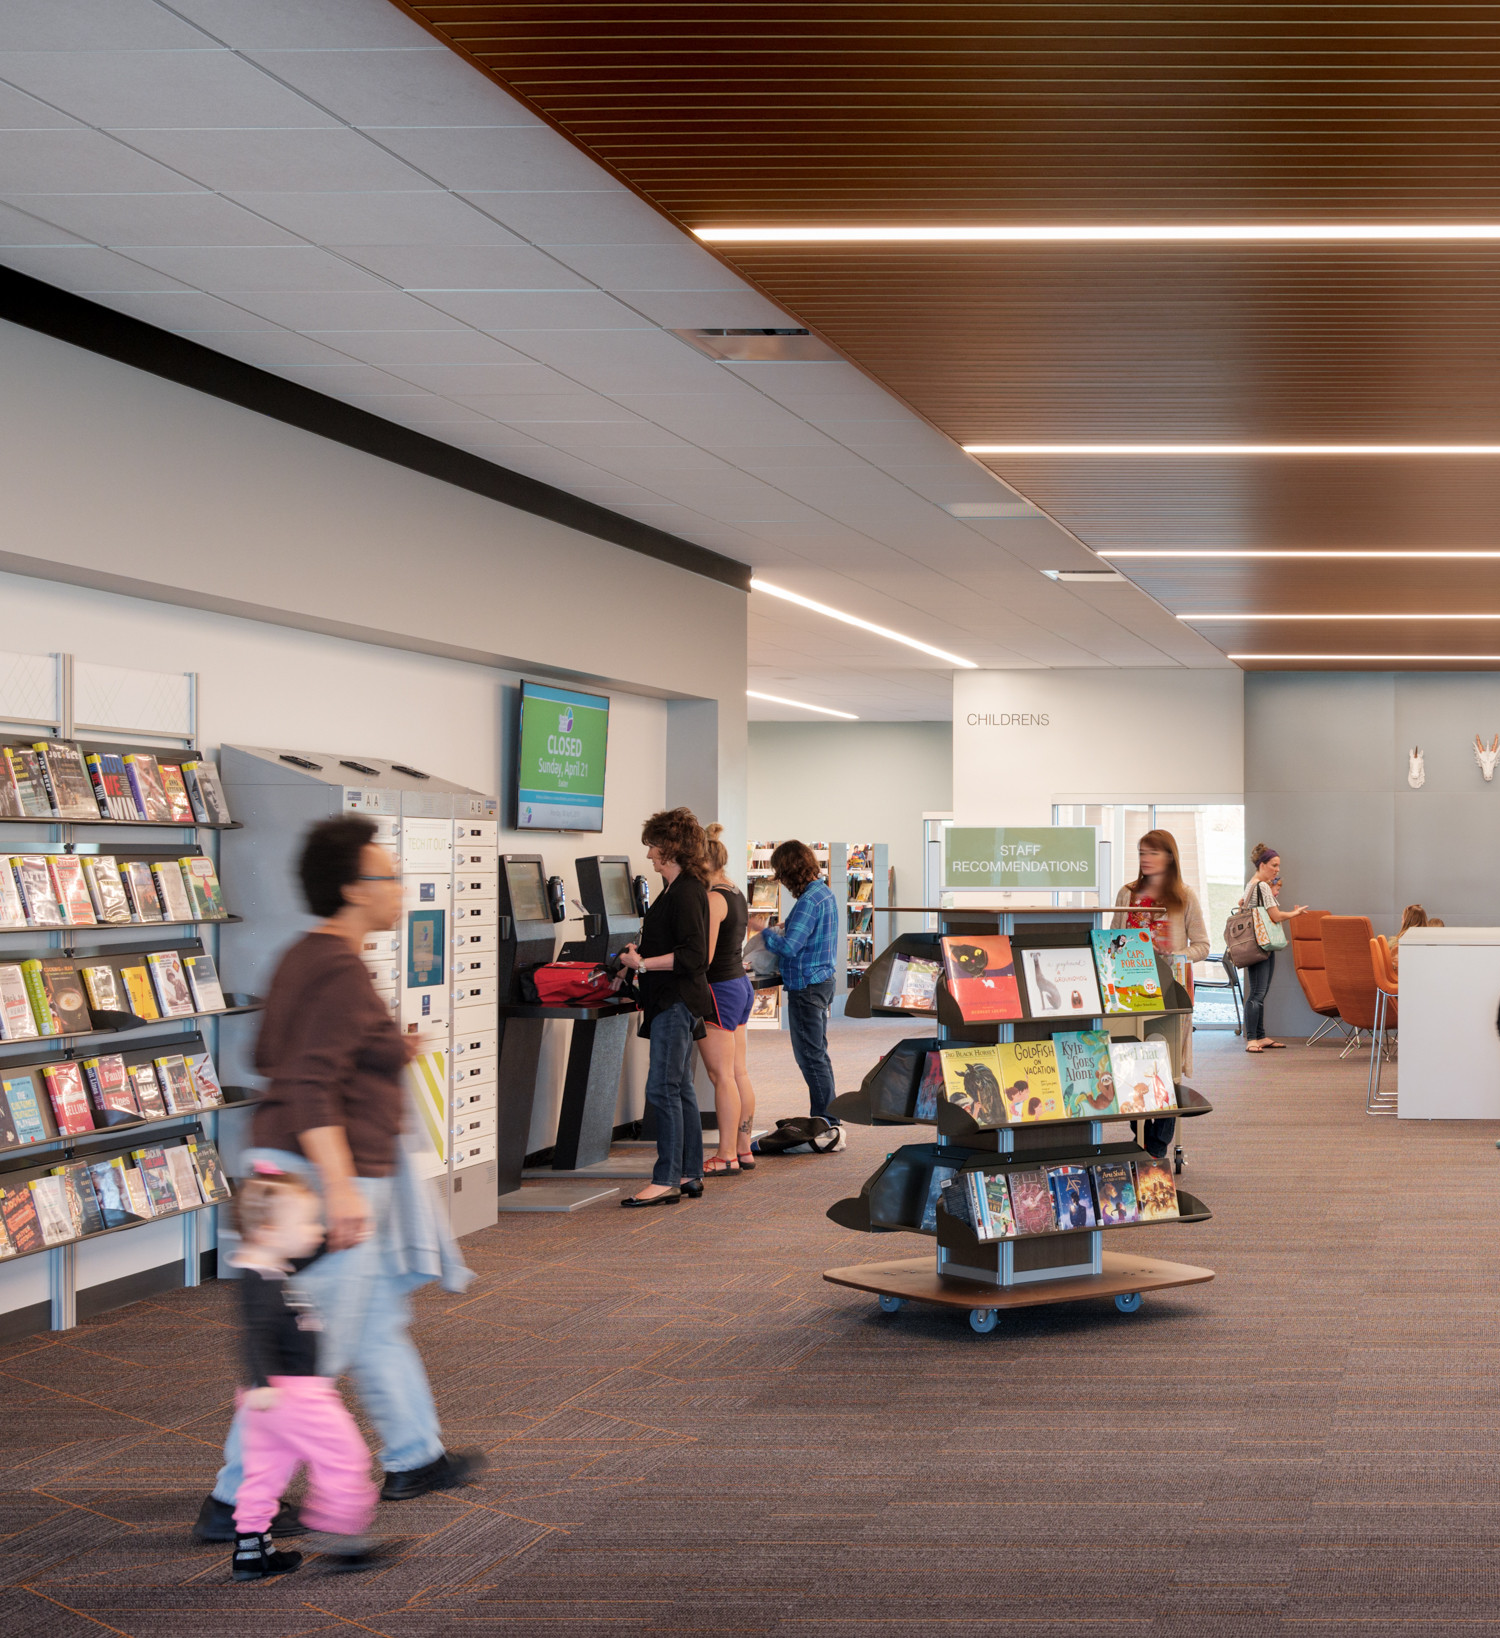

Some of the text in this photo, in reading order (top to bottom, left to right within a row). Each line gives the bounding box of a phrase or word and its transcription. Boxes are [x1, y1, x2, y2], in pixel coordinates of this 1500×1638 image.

[966, 713, 1050, 726] CHILDRENS
[547, 734, 582, 757] CLOSED
[538, 757, 589, 779] Sunday, April 21
[105, 775, 123, 796] WE
[1000, 845, 1041, 856] STAFF
[952, 861, 1089, 872] RECOMMENDATIONS
[1126, 950, 1145, 958] CAPS
[1121, 959, 1154, 968] FOR SALE
[1024, 1066, 1056, 1075] VACATION
